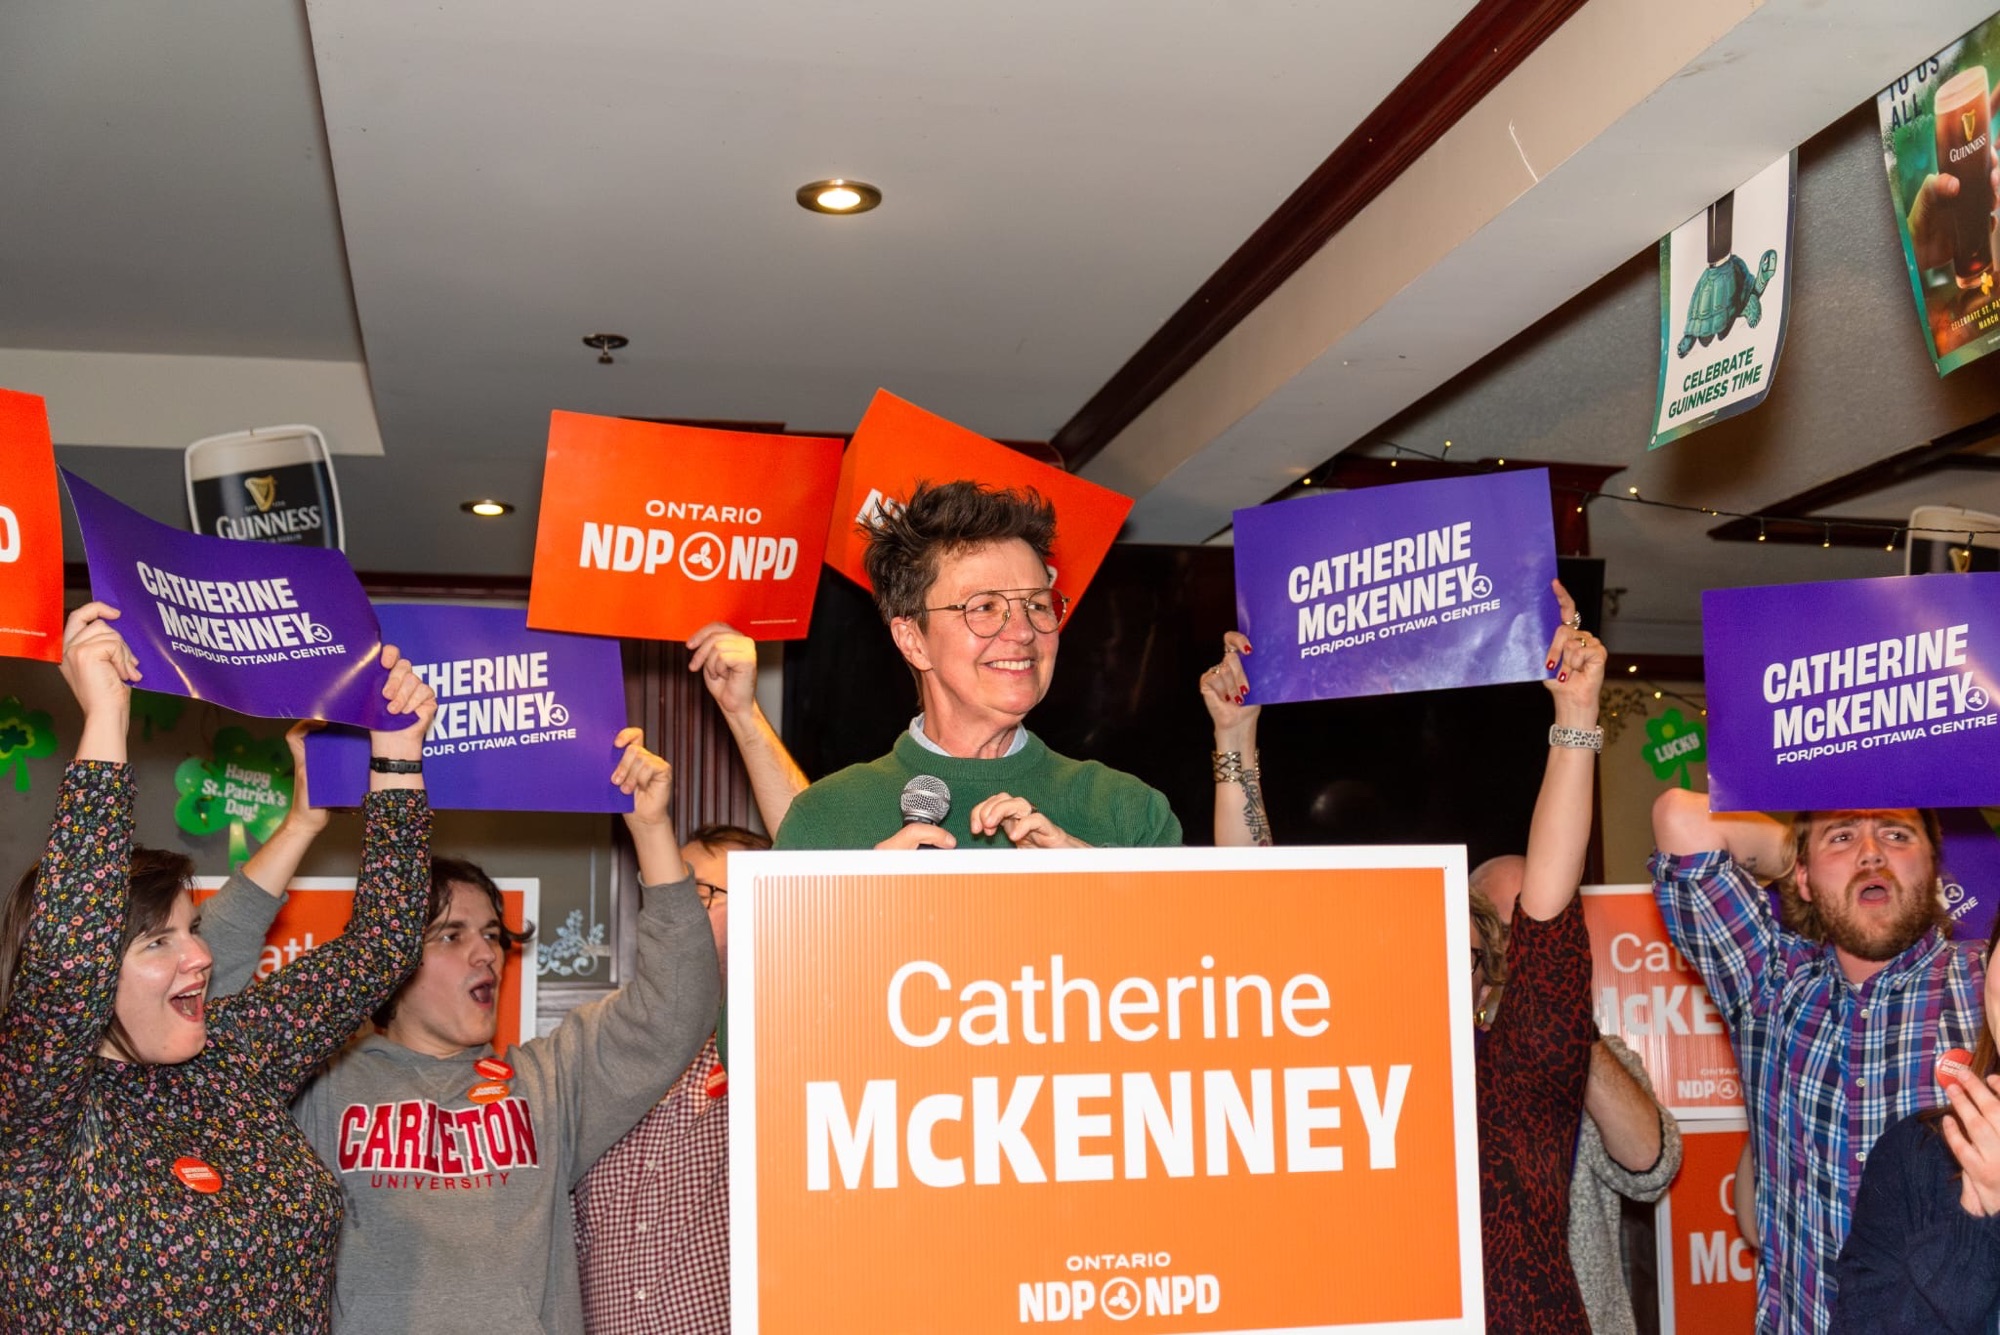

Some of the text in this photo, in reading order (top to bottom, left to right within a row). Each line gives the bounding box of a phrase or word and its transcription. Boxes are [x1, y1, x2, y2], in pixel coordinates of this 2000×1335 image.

[1892, 93, 1921, 131] ALL
[1949, 133, 1987, 163] GUINNESS
[1668, 364, 1763, 418] GUINNESS TIME
[1683, 346, 1755, 392] CELEBRATE
[216, 505, 321, 541] GUINNESS
[645, 500, 762, 525] ONTARIO
[579, 521, 798, 581] NDP NPD
[1288, 521, 1472, 604] CATHERINE
[136, 561, 299, 614] CATHERINE
[1298, 562, 1479, 645] McKENNEY
[156, 601, 315, 652] McKENNEY
[1300, 598, 1501, 660] FOR/POUR OTTAWA CENTRE
[171, 640, 346, 666] FOR/POUR OTTAWA CENTRE
[411, 651, 548, 698] THERINE
[1762, 623, 1969, 704] CATHERINE
[425, 691, 555, 742] KENNEY
[1773, 671, 1974, 749] McKENNEY
[458, 735, 518, 753] OTTAWA
[520, 728, 577, 745] CENTRE
[1776, 713, 1998, 765] FOR/POUR OTTAWA CENTRE
[223, 782, 287, 808] Patrick's
[225, 763, 271, 789] Happy
[224, 799, 259, 823] Day!
[887, 954, 1331, 1048] Catherine
[1677, 1080, 1715, 1099] NDP
[337, 1096, 540, 1176] CARLETON
[806, 1064, 1413, 1191] McKENNEY
[370, 1172, 511, 1190] UNIVERSITY
[1066, 1252, 1172, 1271] ONTARIO
[1019, 1273, 1220, 1323] NDP NPD
